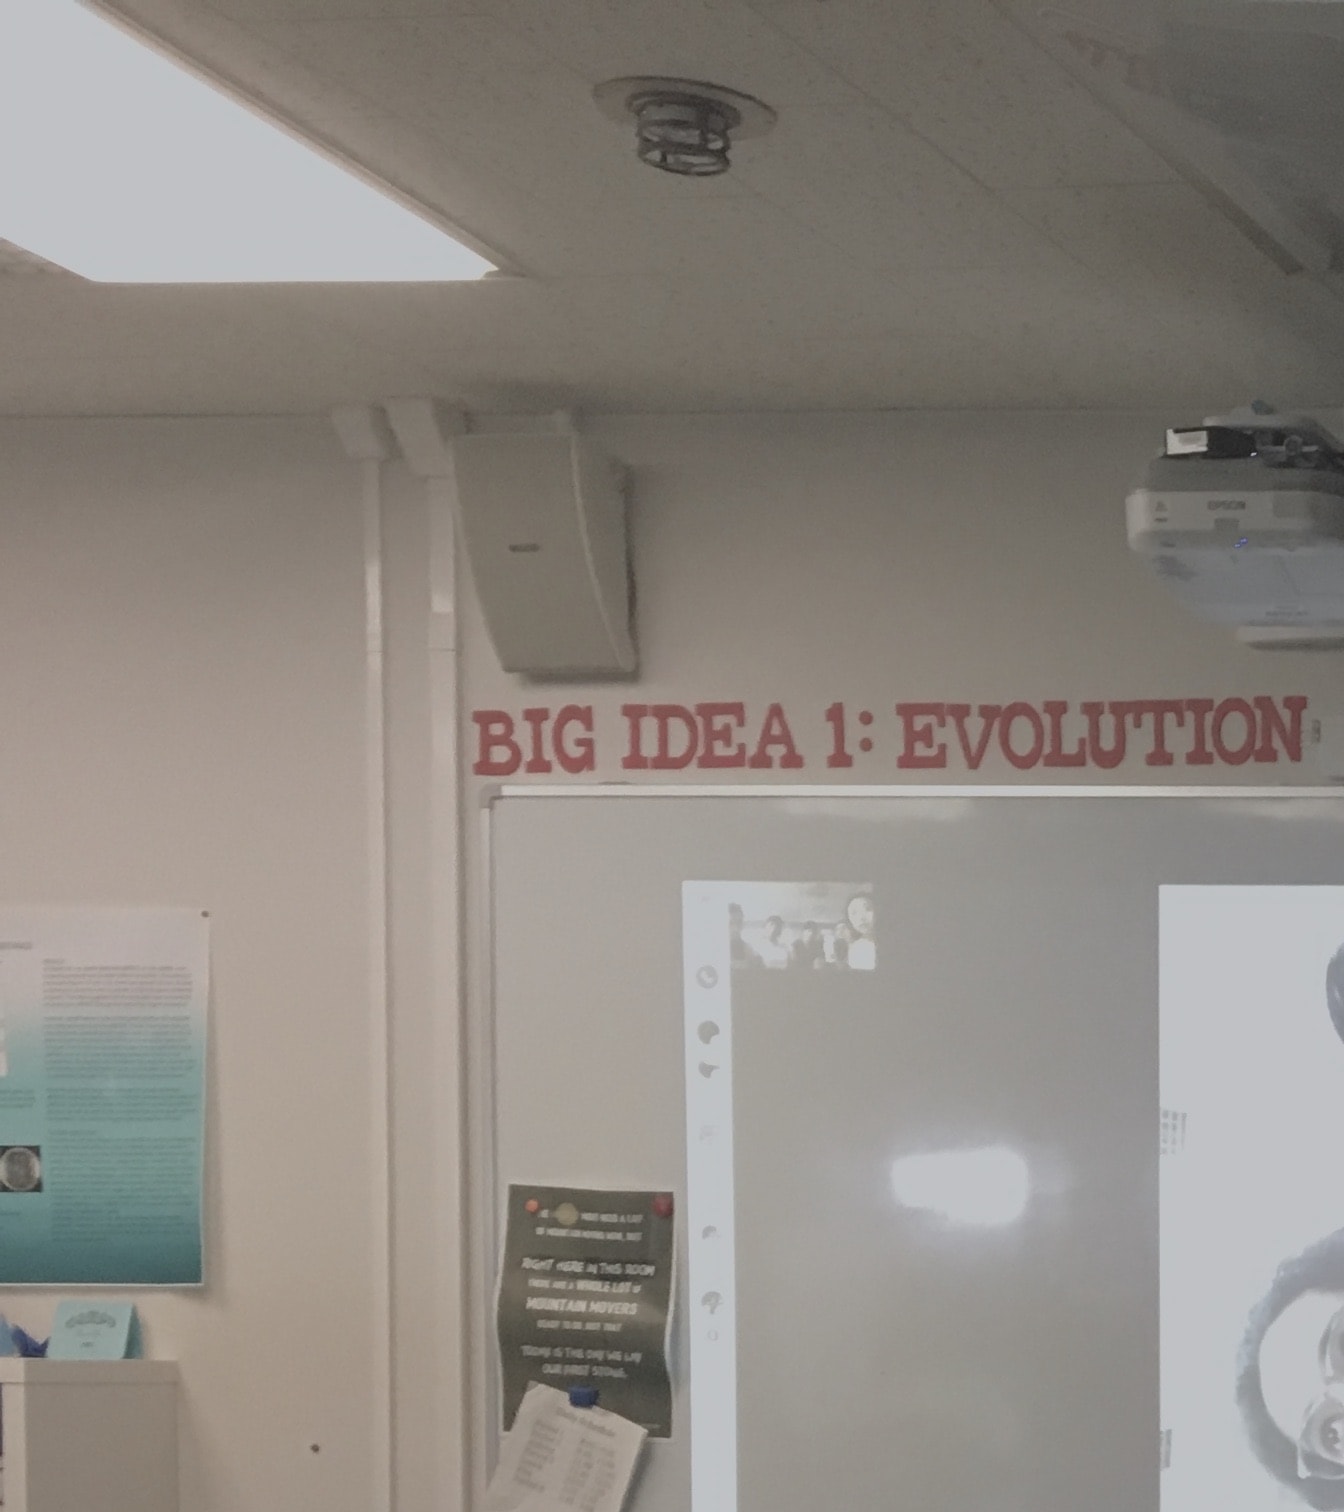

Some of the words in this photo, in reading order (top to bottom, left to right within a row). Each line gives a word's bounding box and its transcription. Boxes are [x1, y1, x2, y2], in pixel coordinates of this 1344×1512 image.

[472, 706, 594, 775] BIG
[622, 702, 803, 770] IDEA
[826, 702, 875, 769] 1:
[897, 696, 1309, 770] EVOLUTION
[526, 1297, 587, 1313] MOUNTAIN
[588, 1300, 638, 1315] MOVERS
